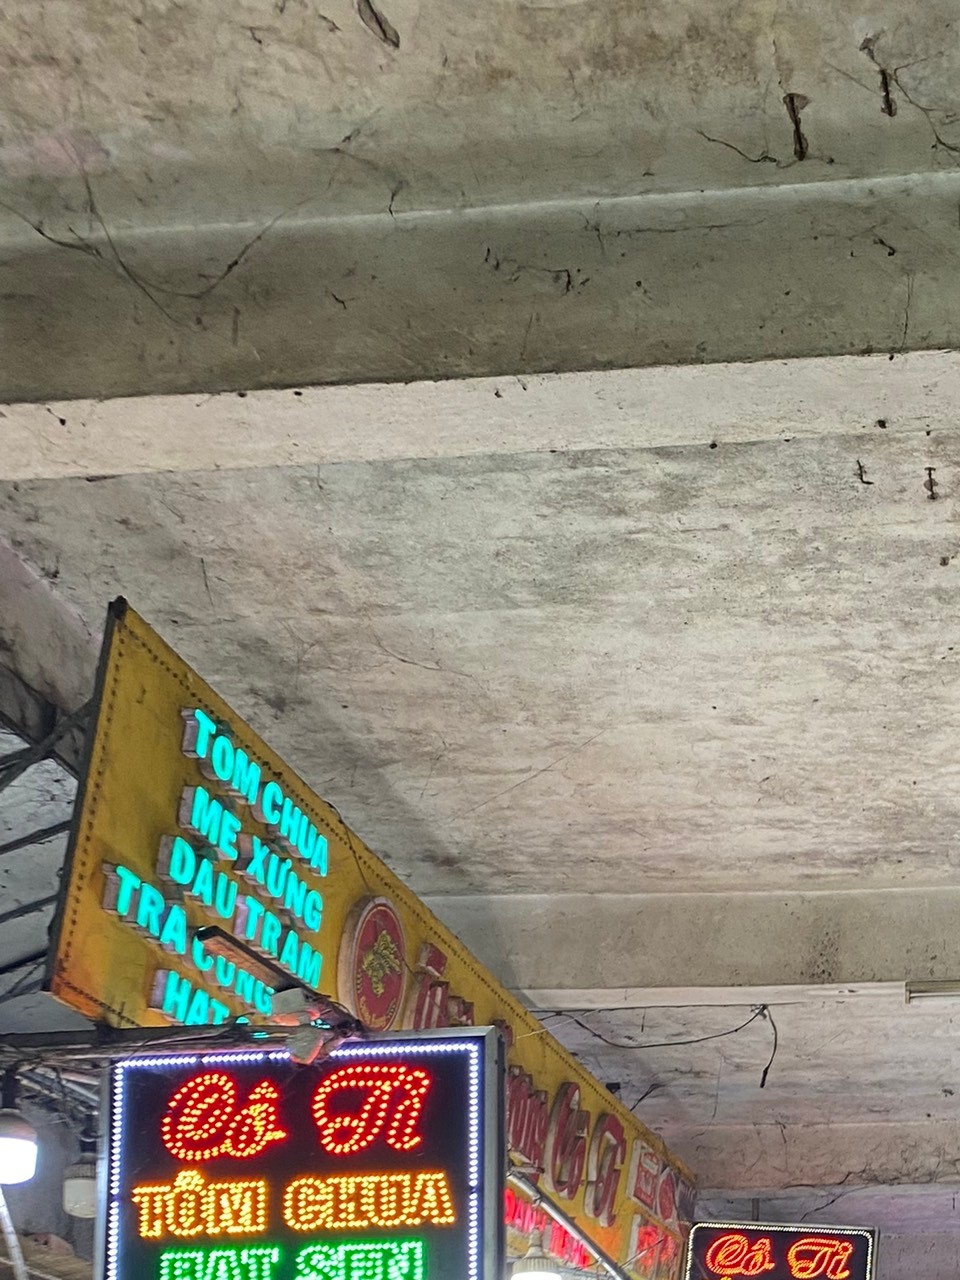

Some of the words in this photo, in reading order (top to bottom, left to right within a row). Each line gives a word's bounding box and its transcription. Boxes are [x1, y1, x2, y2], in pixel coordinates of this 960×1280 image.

[262, 781, 328, 877] CHUA
[132, 1169, 269, 1238] TÔM
[282, 1172, 455, 1231] CHUA
[706, 1234, 776, 1276] Cô
